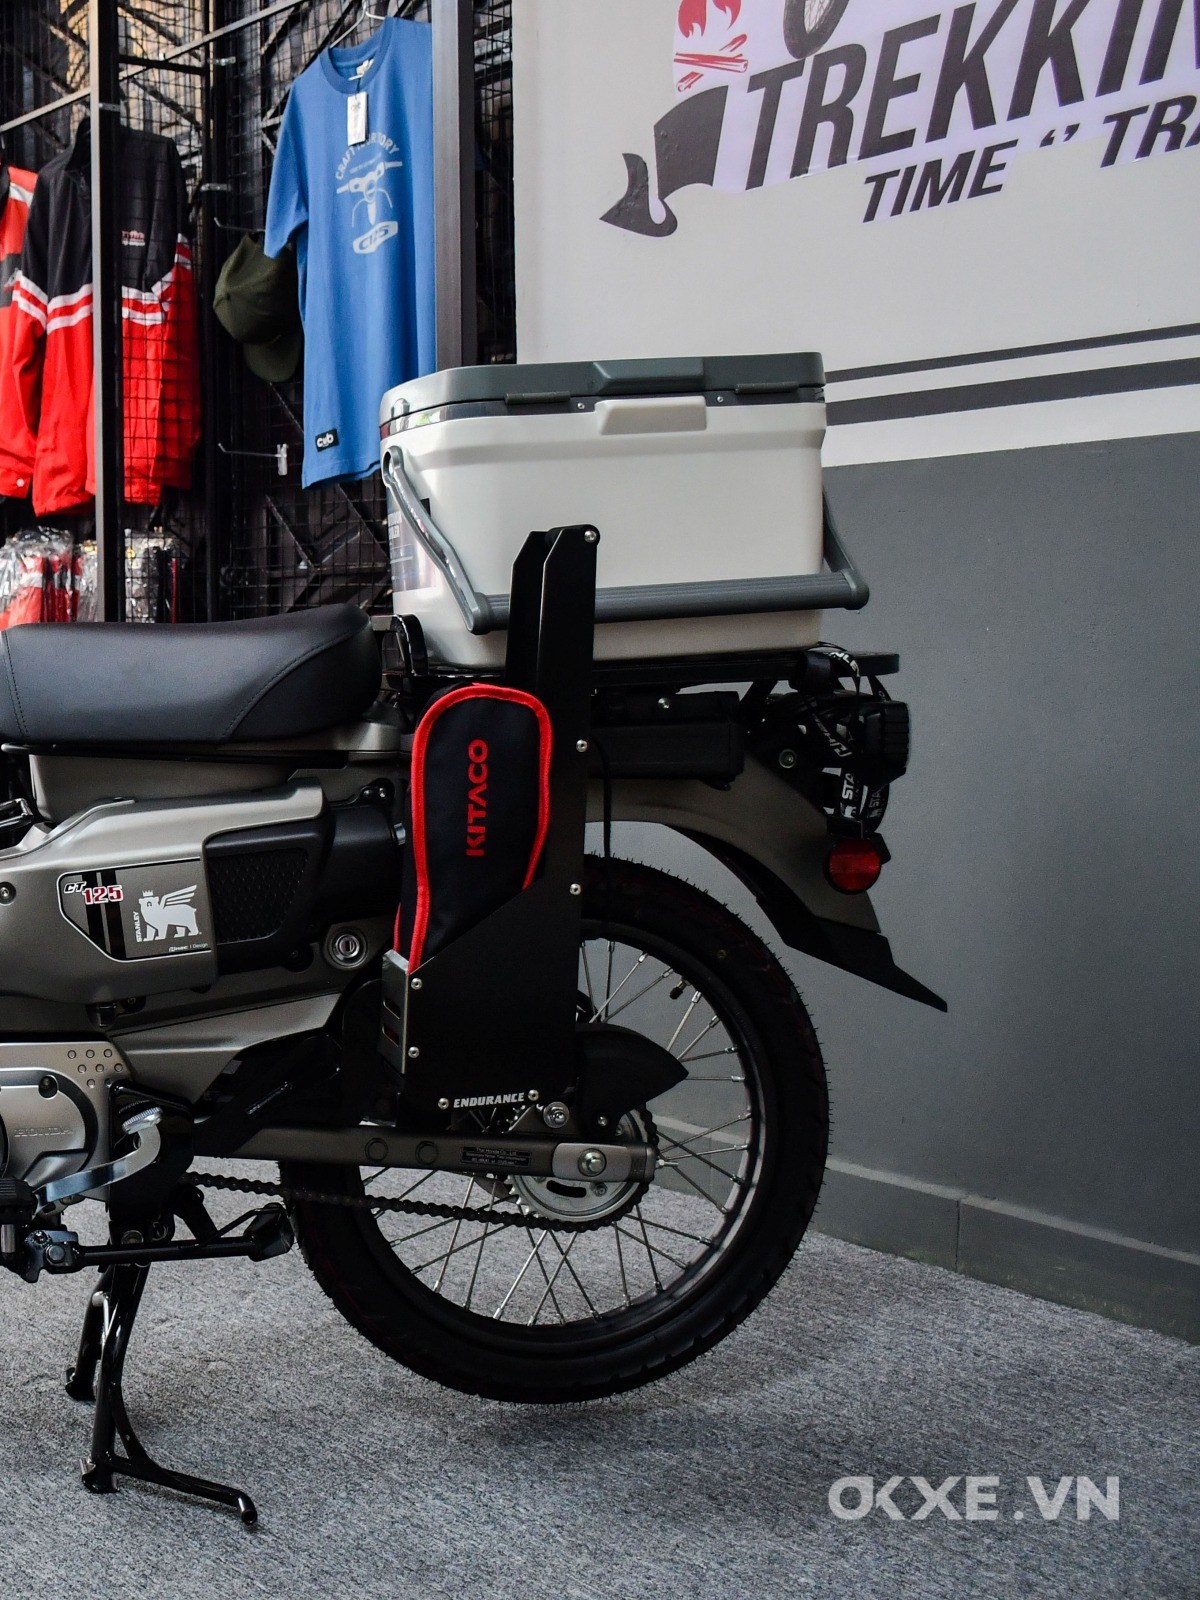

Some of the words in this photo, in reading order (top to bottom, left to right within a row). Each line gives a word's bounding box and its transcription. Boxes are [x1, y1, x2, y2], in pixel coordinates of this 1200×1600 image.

[862, 139, 1019, 223] TIME
[1100, 94, 1200, 168] TR
[466, 739, 488, 856] KITACO
[64, 881, 87, 894] CT
[82, 884, 123, 905] 125
[133, 911, 142, 942] STANLEY
[453, 1092, 525, 1108] ENDURANCE
